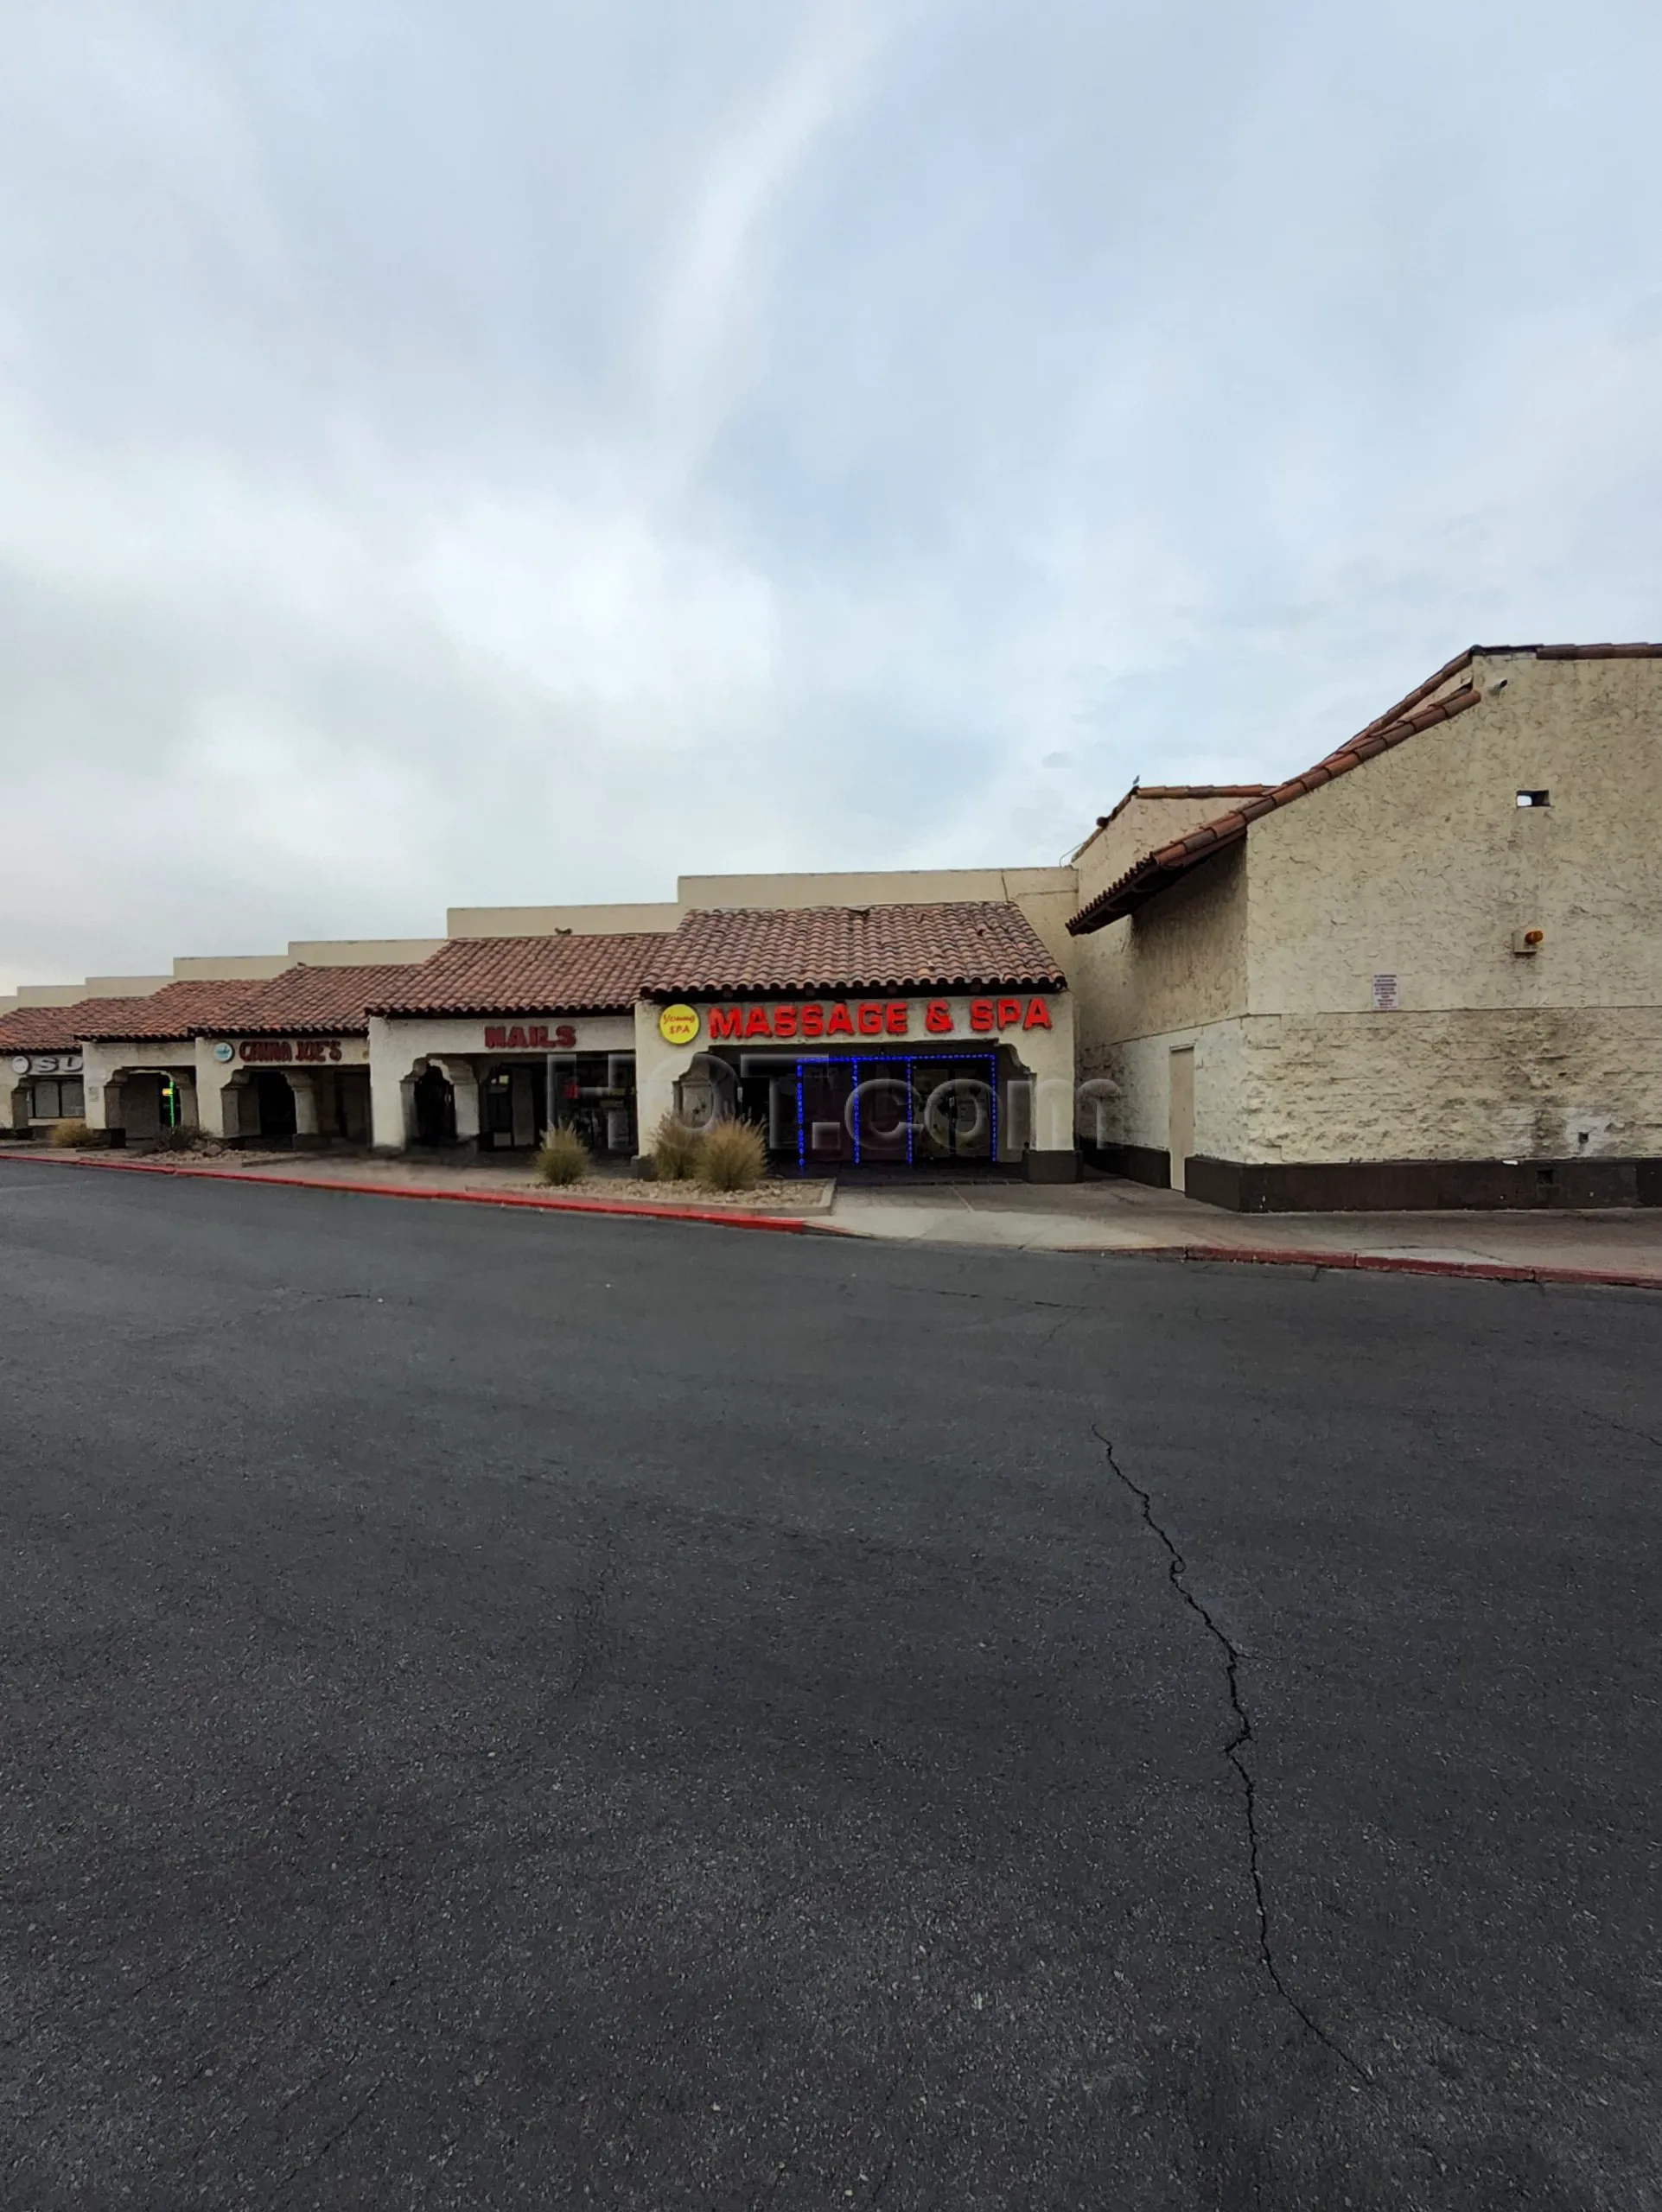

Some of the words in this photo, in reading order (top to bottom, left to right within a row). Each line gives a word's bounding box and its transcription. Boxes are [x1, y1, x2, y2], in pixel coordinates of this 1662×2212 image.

[670, 1025, 691, 1034] SPA
[708, 1001, 908, 1040] MASSAGE
[926, 998, 954, 1033] &
[970, 996, 1052, 1032] SPA
[484, 1025, 577, 1049] NAILS
[295, 1039, 342, 1062] JOE'S
